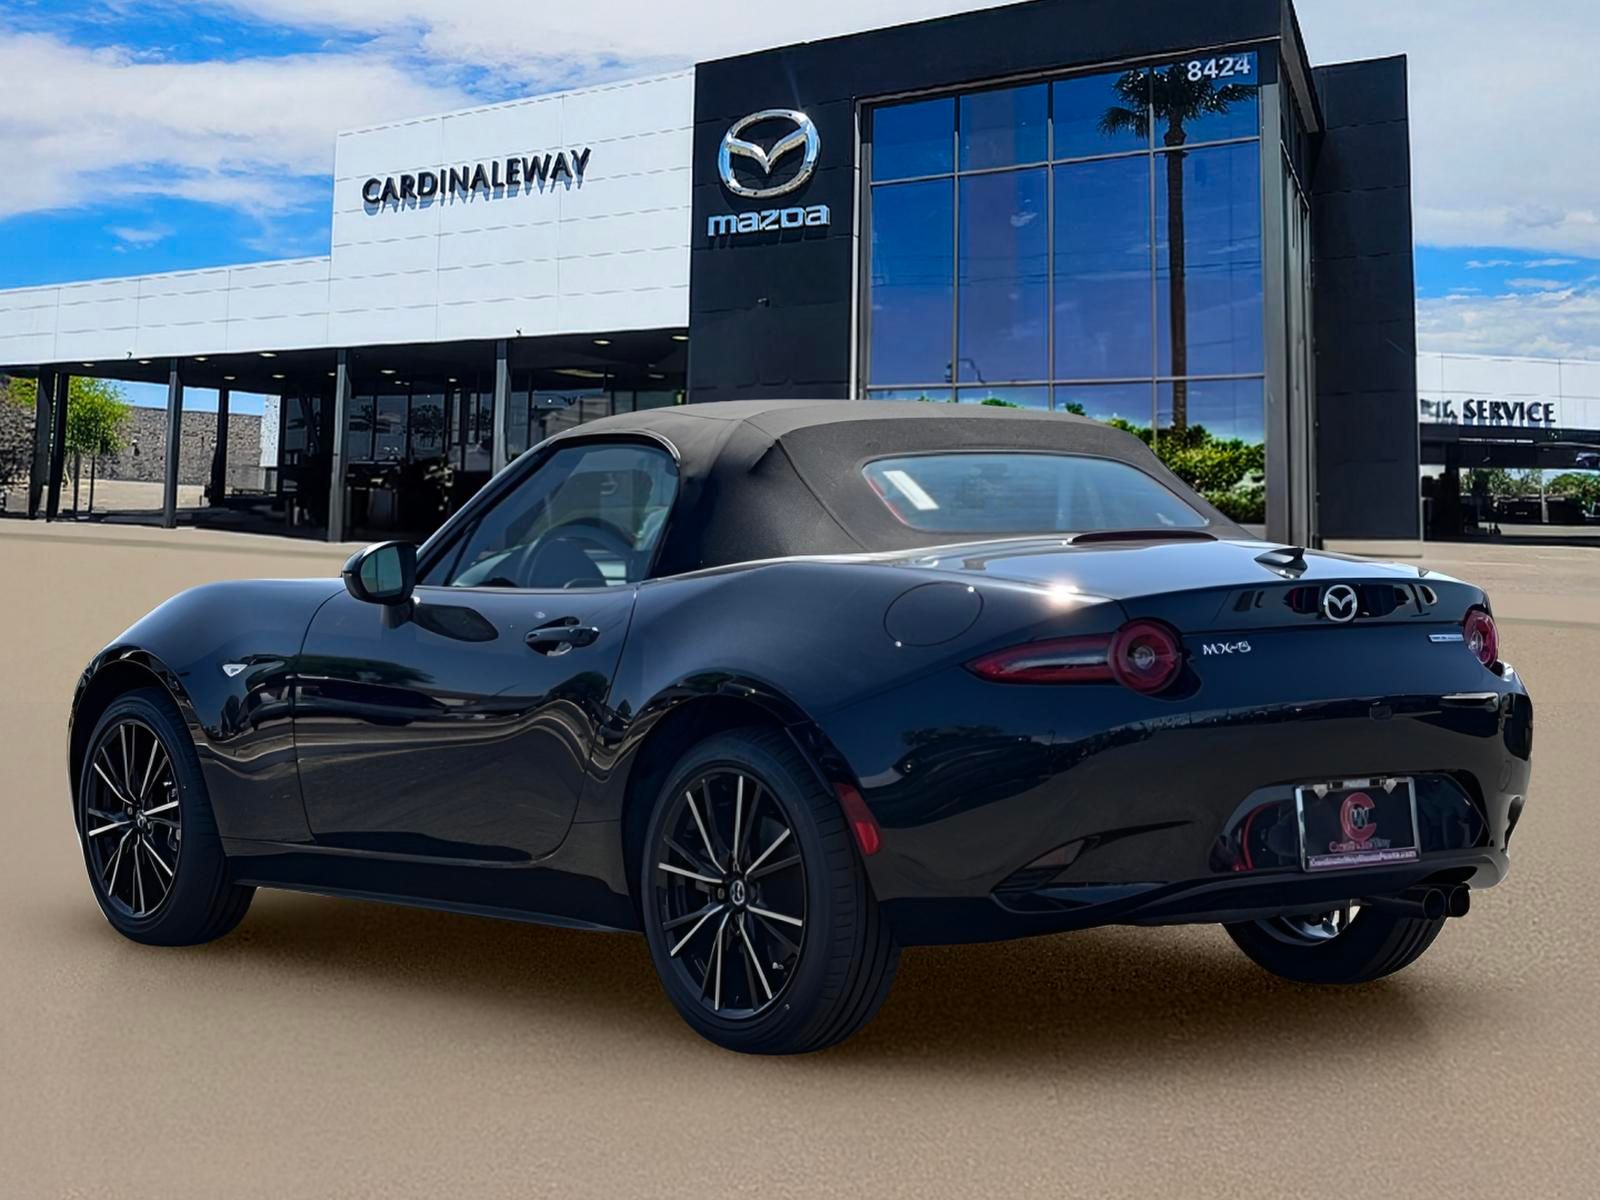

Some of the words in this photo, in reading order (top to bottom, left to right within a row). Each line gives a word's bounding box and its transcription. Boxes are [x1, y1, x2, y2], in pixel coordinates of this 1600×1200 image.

[1187, 56, 1251, 82] 8424
[362, 147, 592, 202] CARDINALEWAY
[707, 204, 830, 236] mazda
[1462, 398, 1556, 423] SERVICE
